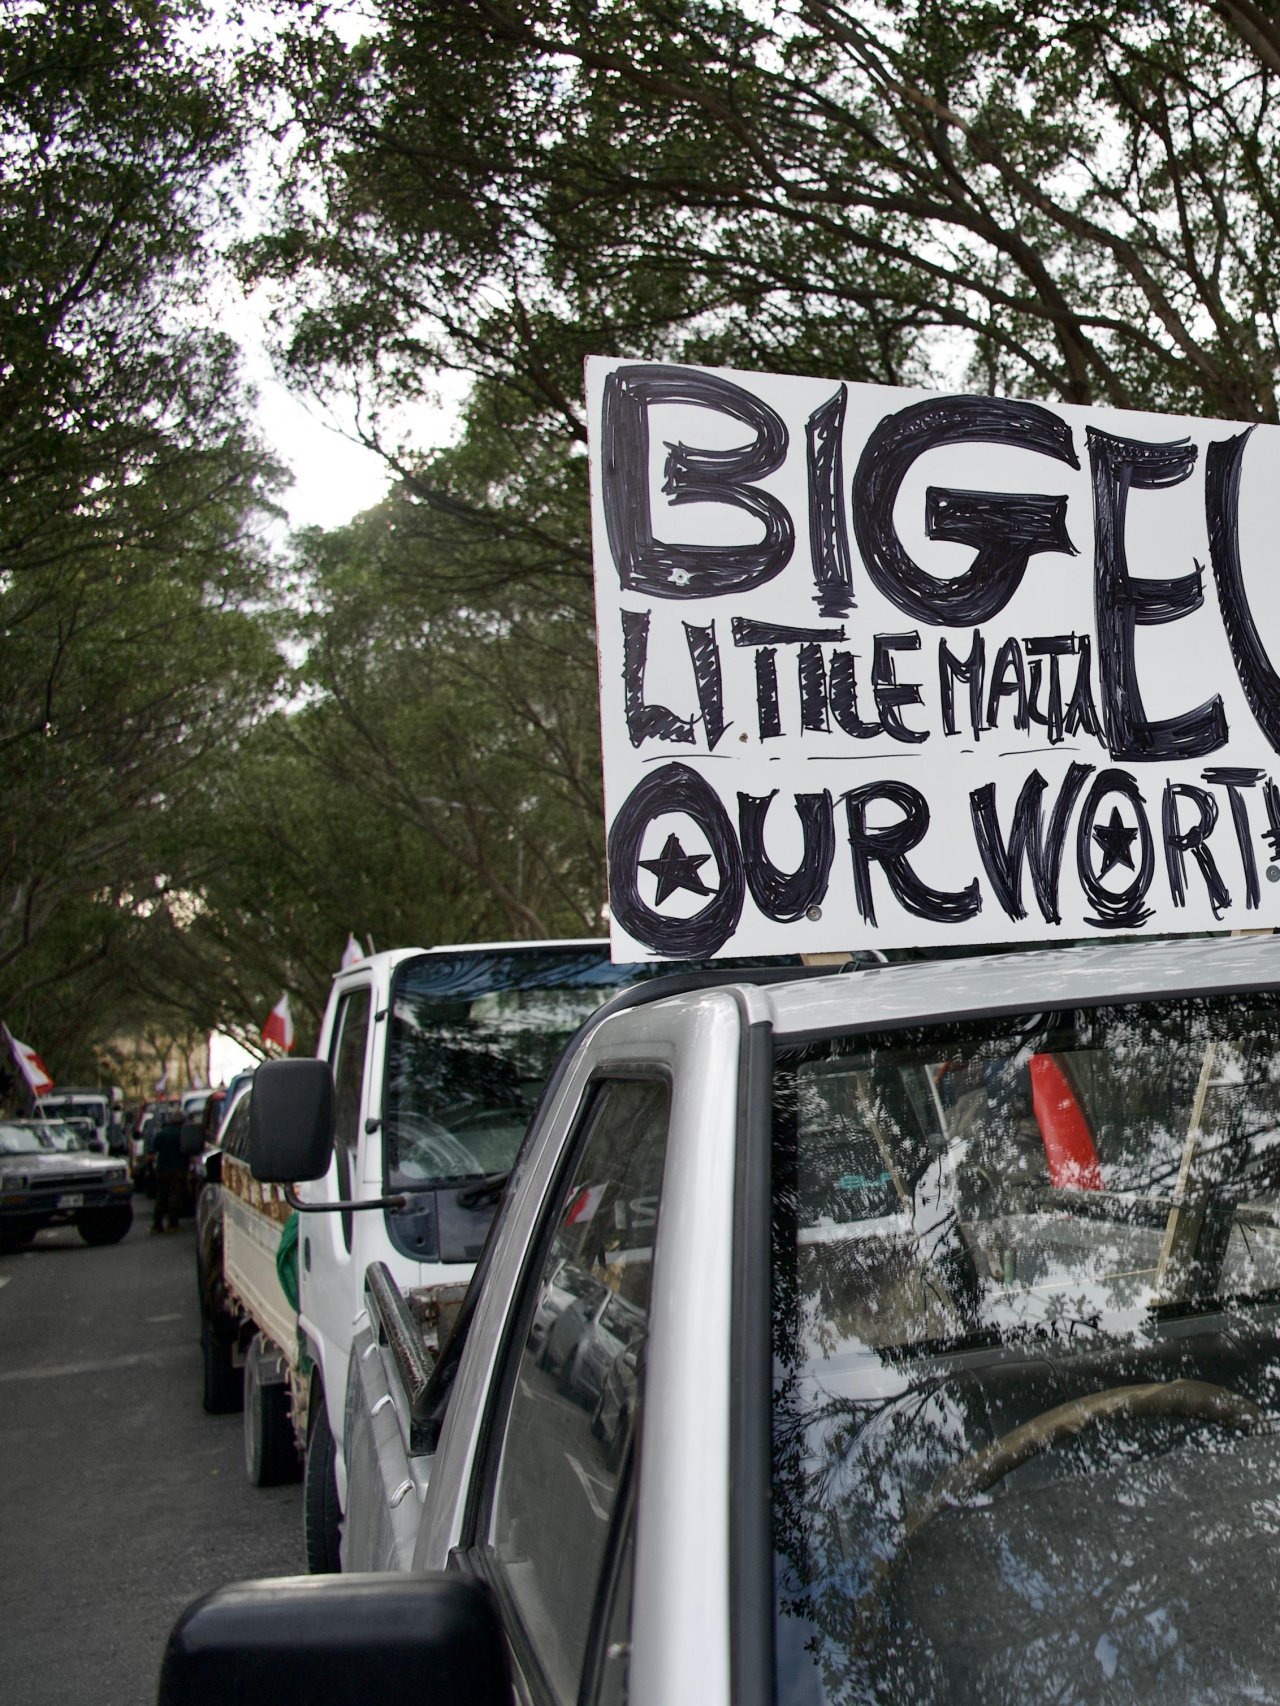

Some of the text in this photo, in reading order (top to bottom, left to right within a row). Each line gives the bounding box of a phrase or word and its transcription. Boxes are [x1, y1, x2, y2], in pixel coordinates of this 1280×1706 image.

[602, 364, 1081, 627] BIG
[619, 608, 1105, 750] LITTLE MALTA
[608, 762, 982, 959] OUR
